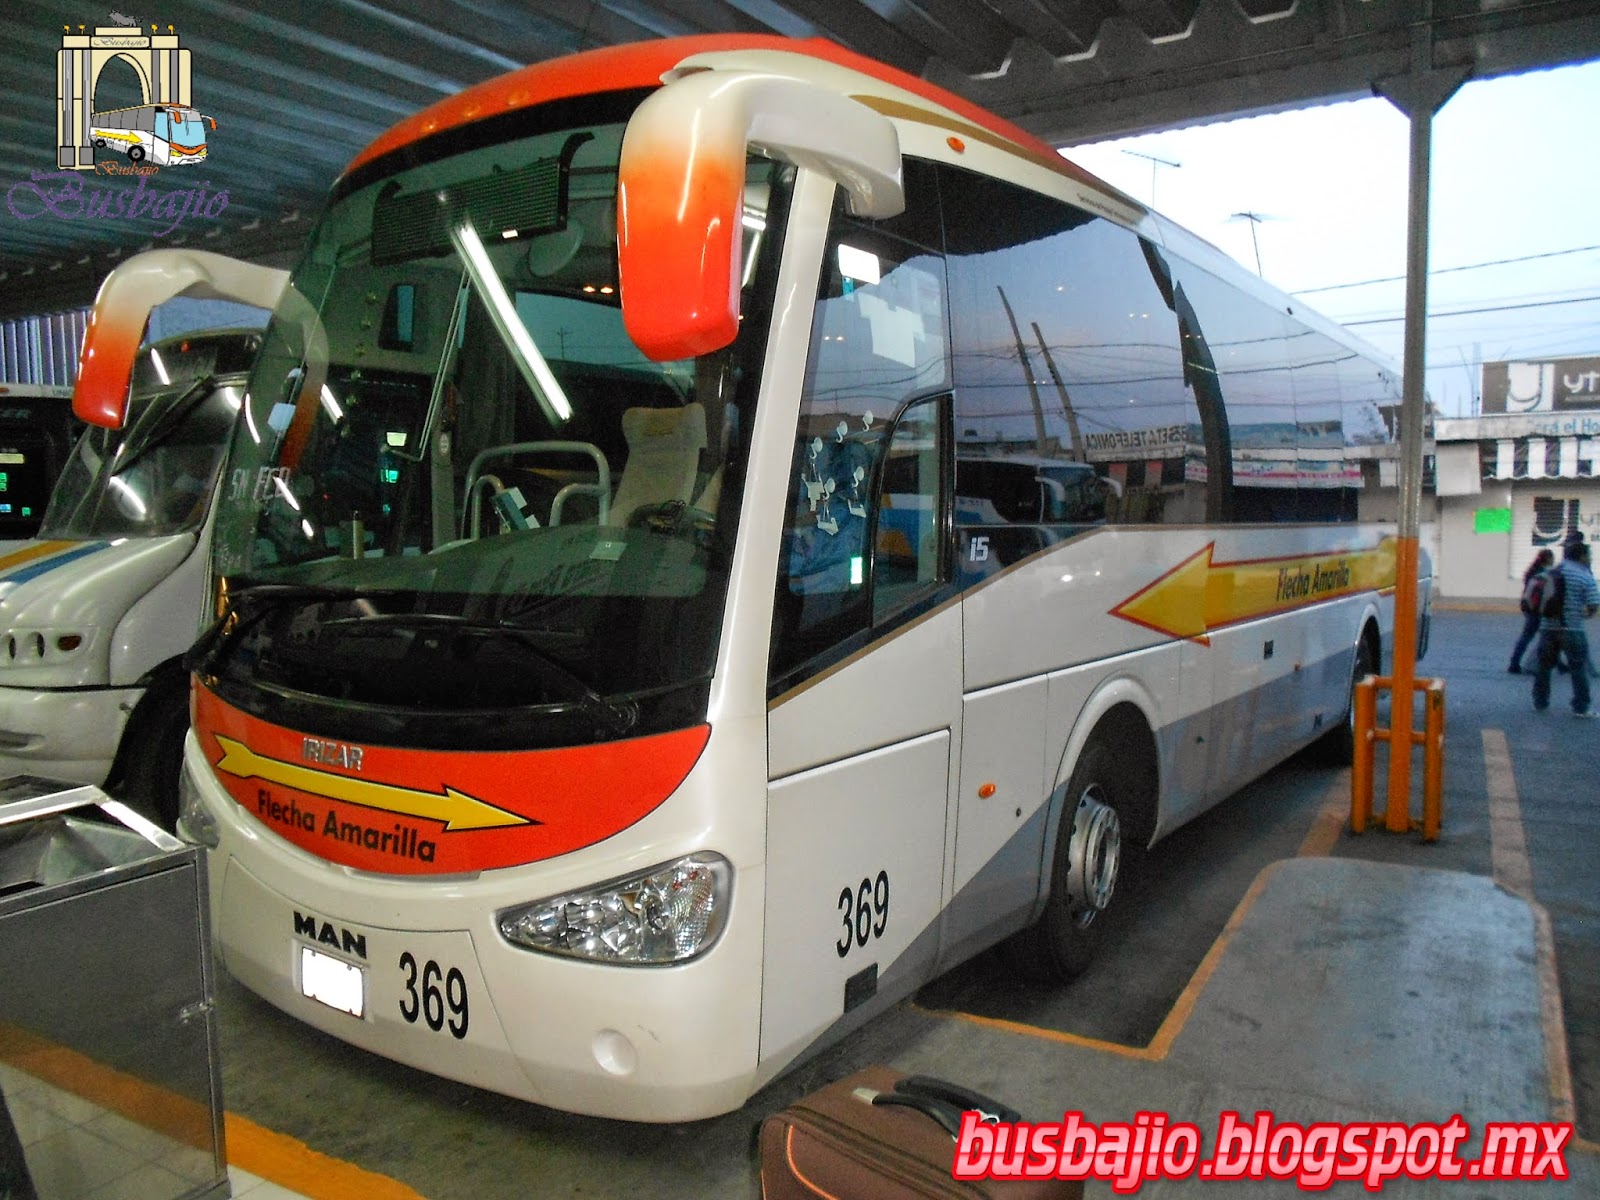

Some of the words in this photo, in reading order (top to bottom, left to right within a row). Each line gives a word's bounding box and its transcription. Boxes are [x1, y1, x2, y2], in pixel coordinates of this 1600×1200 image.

[1276, 564, 1310, 601] Flecha
[303, 736, 363, 771] IRIZAR
[256, 788, 316, 832] Flecha
[323, 809, 437, 863] Amarilla
[293, 910, 368, 960] MAN
[836, 870, 890, 958] 369
[399, 951, 470, 1040] 369
